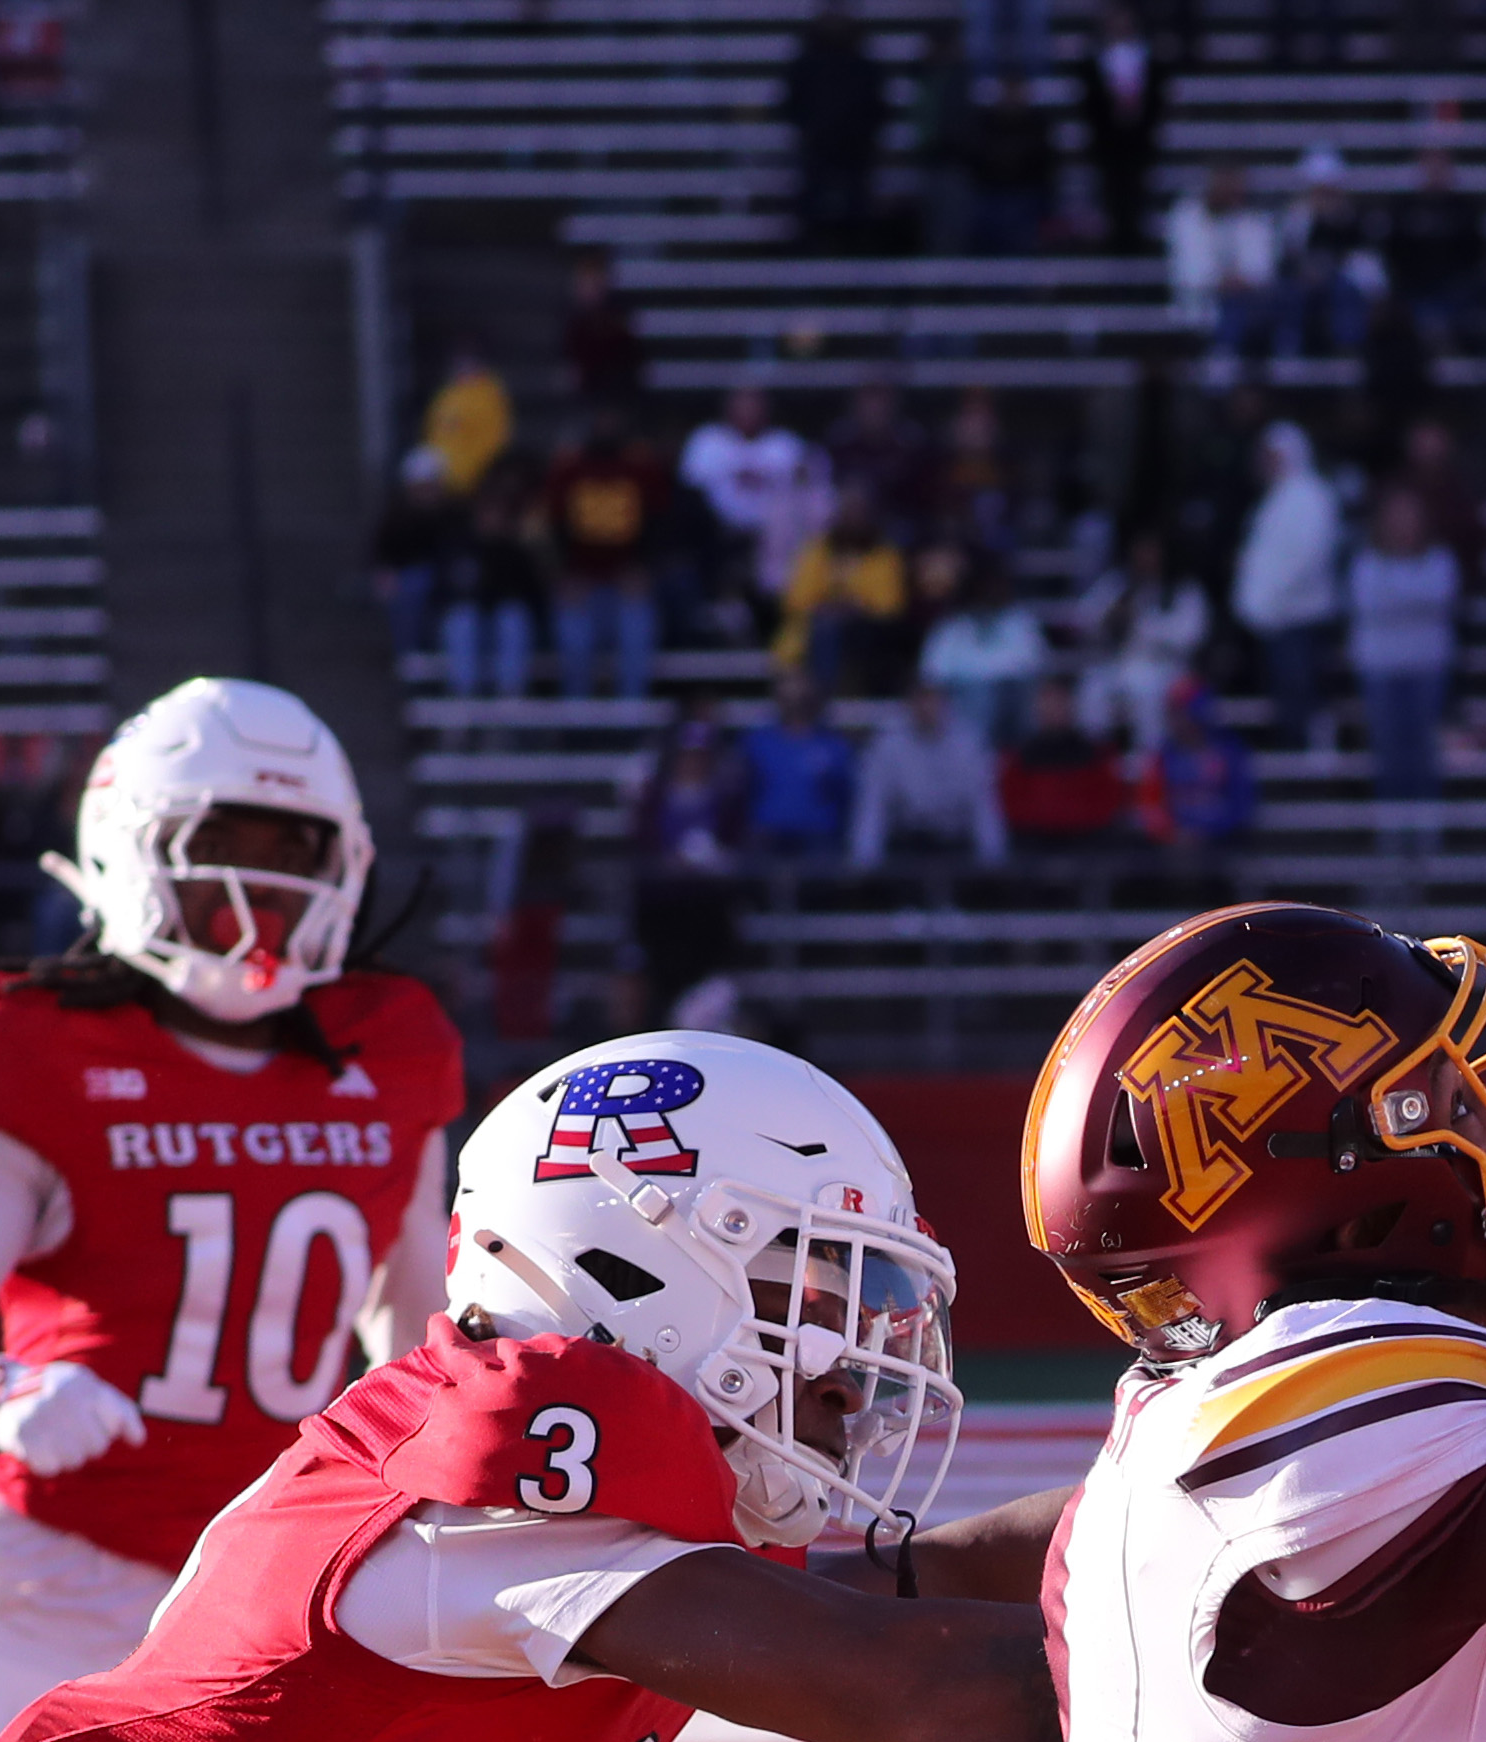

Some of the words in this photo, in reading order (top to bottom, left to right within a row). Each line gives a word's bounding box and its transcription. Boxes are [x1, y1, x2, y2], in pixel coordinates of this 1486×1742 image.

[107, 1121, 392, 1170] RUTGERS
[533, 1059, 705, 1184] R
[1119, 958, 1400, 1233] M
[841, 1186, 864, 1214] R
[139, 1190, 372, 1425] 10
[516, 1405, 600, 1515] 3
